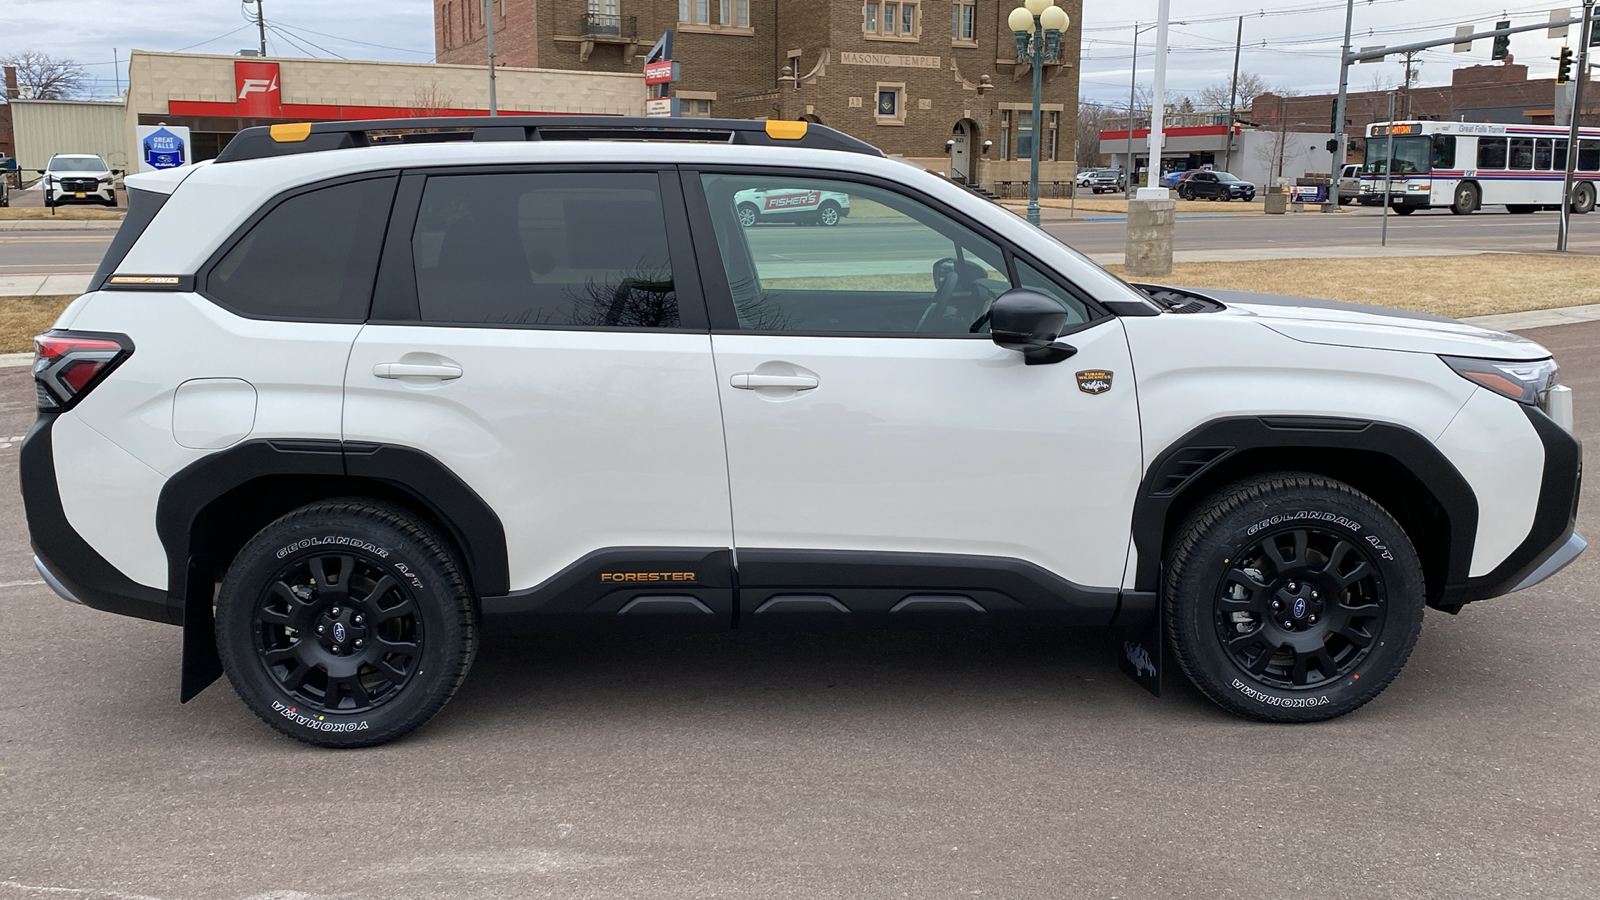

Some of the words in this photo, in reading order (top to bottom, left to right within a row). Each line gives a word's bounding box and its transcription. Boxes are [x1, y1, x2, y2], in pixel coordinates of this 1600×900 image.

[843, 53, 891, 64] MASONIC
[899, 56, 939, 66] TEMPLE
[1374, 126, 1379, 135] 2
[1385, 125, 1412, 135] DWNTOWN
[1459, 124, 1474, 132] Great
[1474, 125, 1488, 133] Falls
[1488, 126, 1505, 134] Transit
[768, 192, 816, 207] FISHER'S
[1246, 510, 1361, 536] GEOLANDAR
[1366, 534, 1394, 561] A/T
[276, 536, 389, 559] GEOLANDAR
[394, 562, 424, 589] A/T
[601, 572, 696, 582] FORESTER
[1231, 678, 1330, 708] YOKOHAMA
[271, 700, 369, 732] YOKOHAMA
